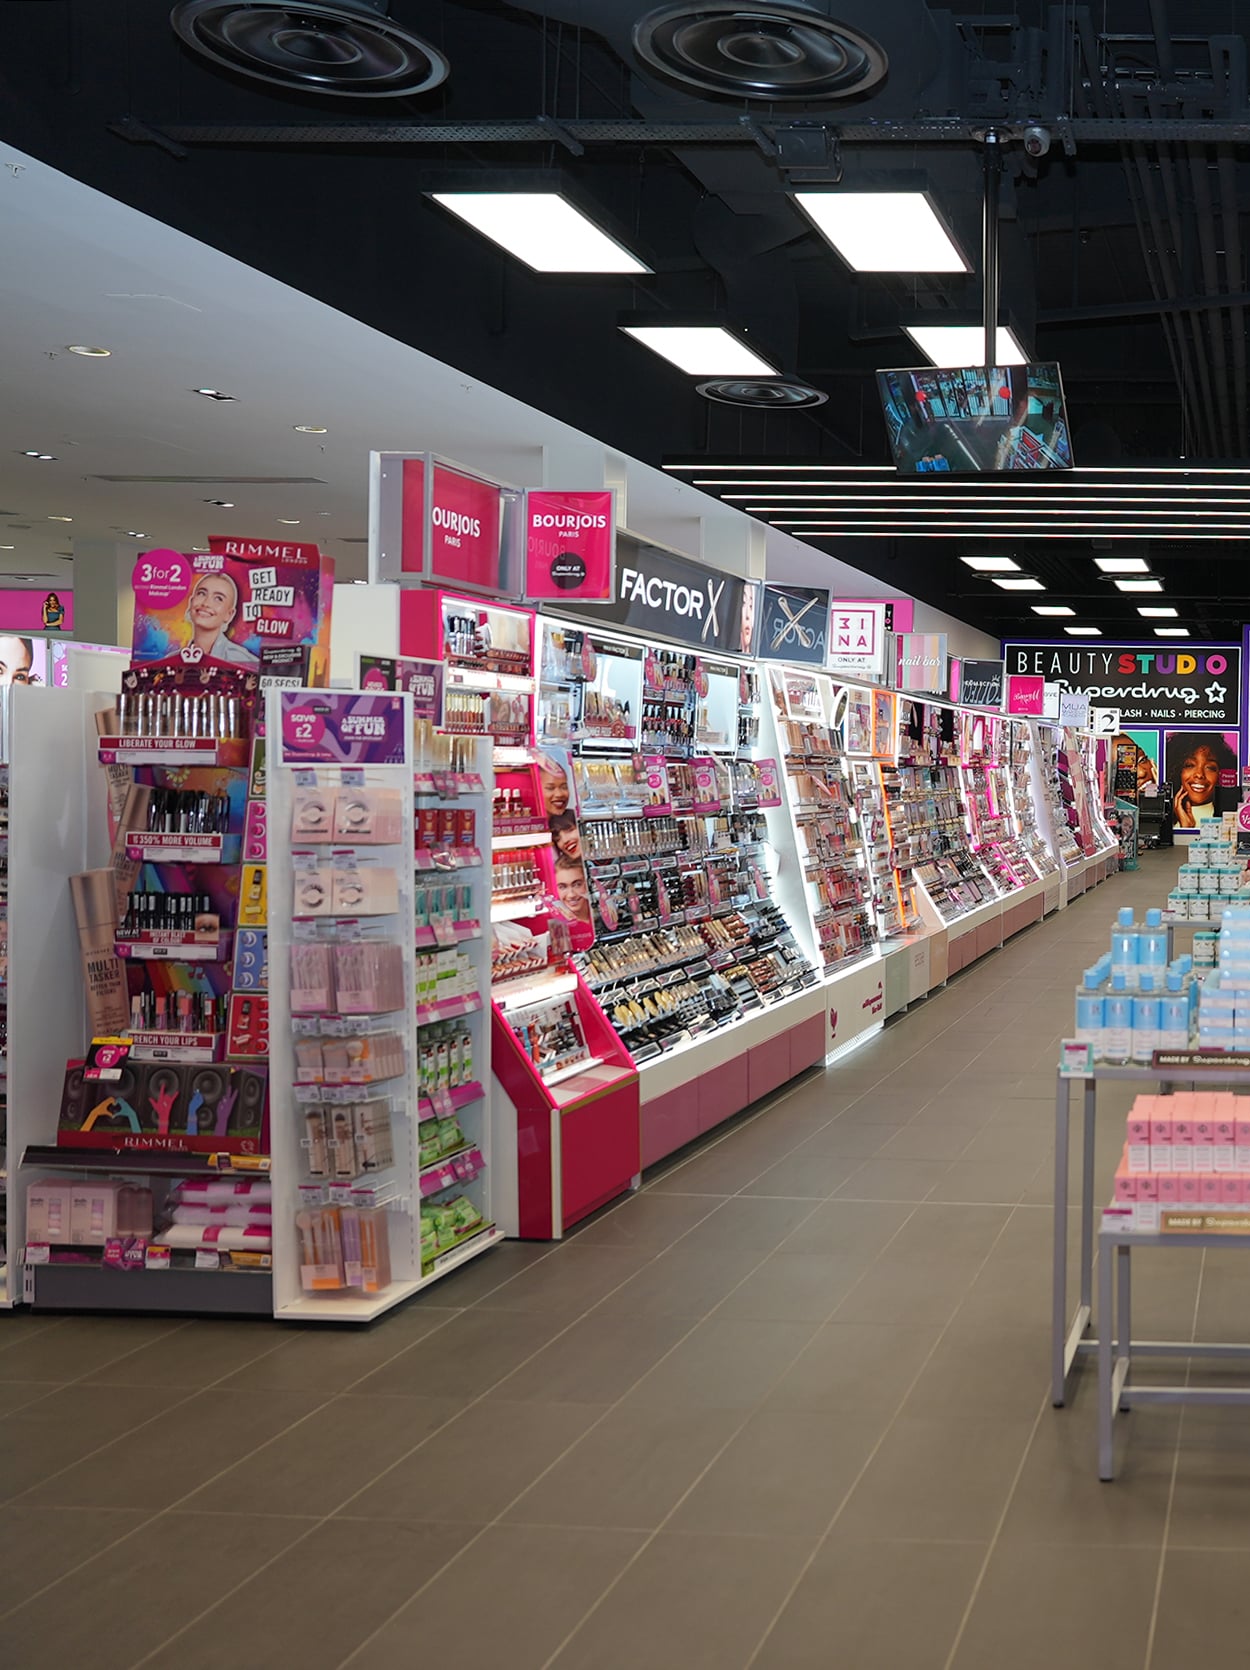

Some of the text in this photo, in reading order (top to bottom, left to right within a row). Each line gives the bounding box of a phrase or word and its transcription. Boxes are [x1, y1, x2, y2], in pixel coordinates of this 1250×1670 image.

[432, 507, 480, 538] OURJOIS
[533, 514, 606, 530] BOURJOIS
[558, 530, 579, 538] PARIS
[444, 534, 461, 548] PARIS
[225, 541, 307, 560] RIMMEL
[252, 571, 273, 584] GET
[255, 589, 290, 602] READY
[620, 568, 704, 619] FACTOR
[256, 620, 289, 635] GLOW
[899, 655, 941, 667] nail bar
[1017, 651, 1228, 675] BEAUTY STUDIO
[291, 714, 316, 722] save
[1119, 709, 1226, 719] LASH NAILS PIERCING
[295, 723, 313, 738] £2
[355, 722, 385, 736] FUN
[119, 738, 196, 748] LIBERATE YOUR GLOW
[139, 835, 160, 845] 350%
[162, 836, 183, 845] MORE
[184, 836, 213, 846] VOLUME
[116, 929, 131, 937] NEW
[88, 958, 119, 973] MULTI
[89, 970, 121, 983] TASKER
[131, 1036, 198, 1046] RENCH YOUR LIPS
[1192, 1055, 1250, 1066] Superdrug
[124, 1136, 186, 1147] RIMMEL
